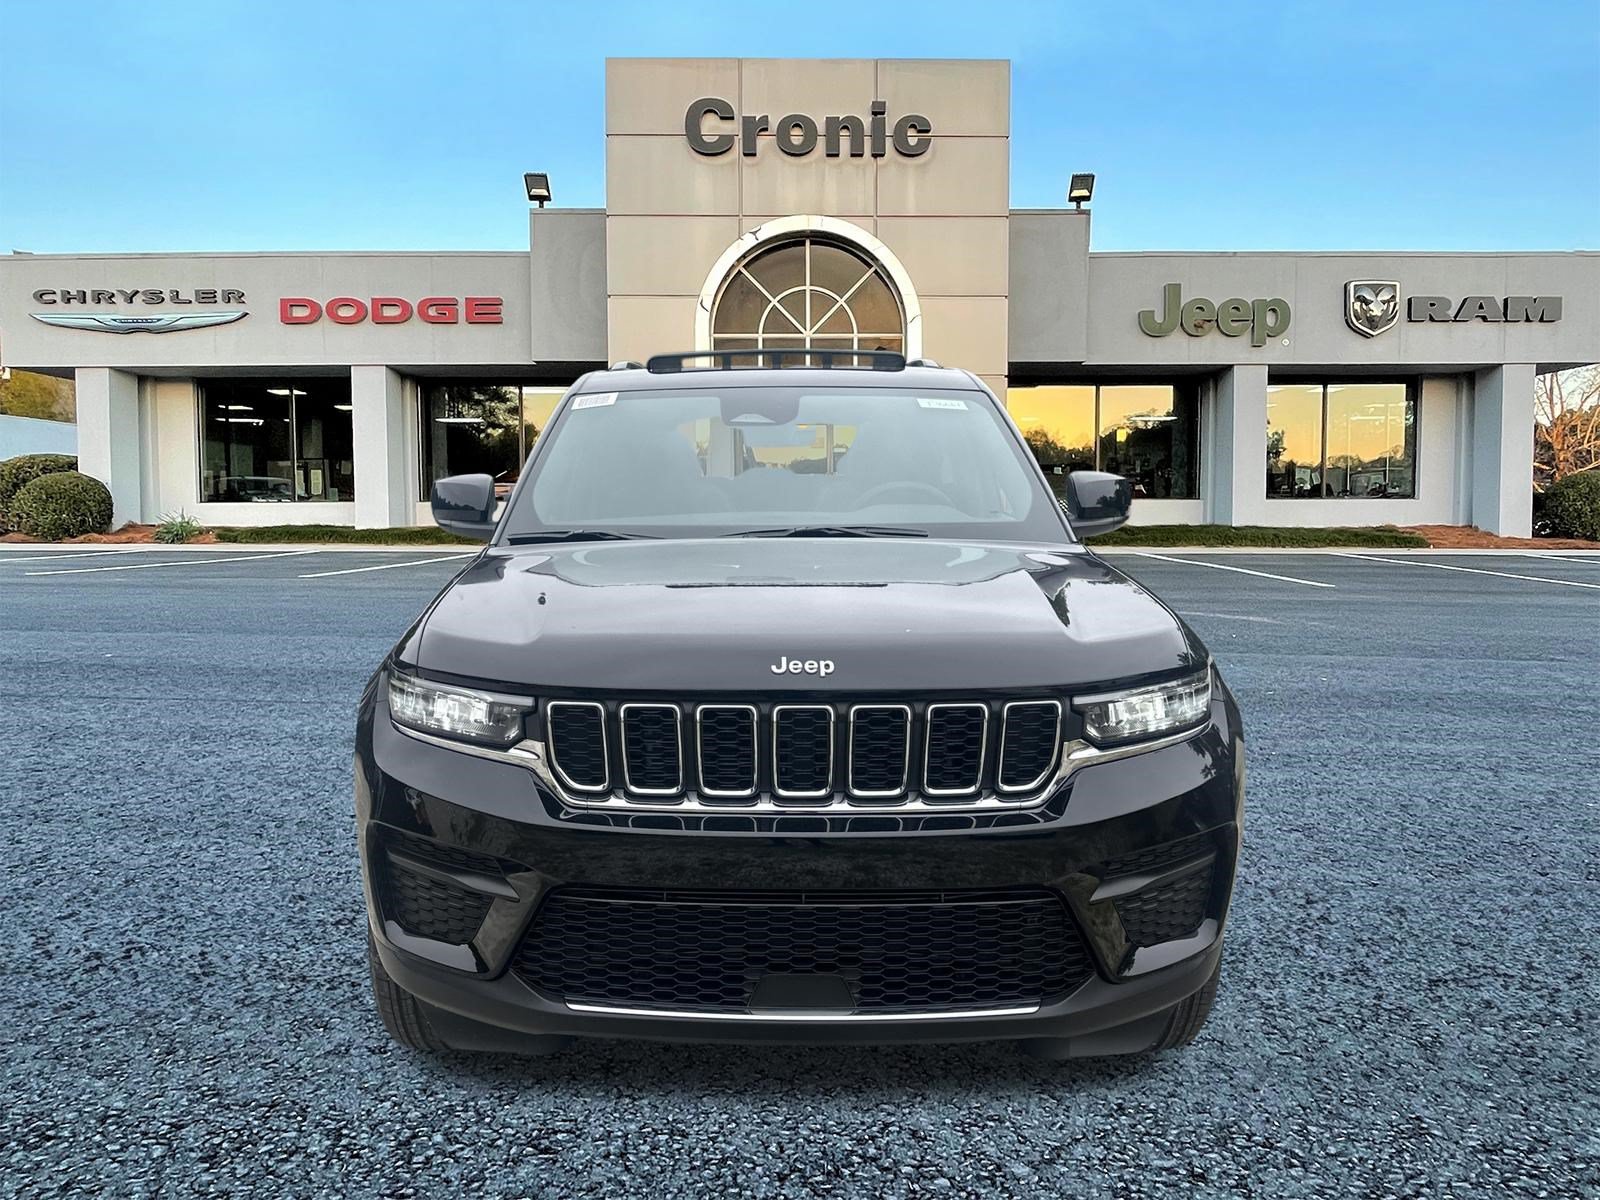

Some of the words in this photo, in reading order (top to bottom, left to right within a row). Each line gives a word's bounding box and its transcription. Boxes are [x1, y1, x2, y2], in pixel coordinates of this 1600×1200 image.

[684, 97, 932, 158] Cronic
[32, 288, 248, 305] CHRYSLER
[279, 296, 504, 325] DODGE
[1407, 296, 1563, 323] RAM
[1138, 283, 1292, 348] Jeep
[770, 656, 835, 678] Jeep
